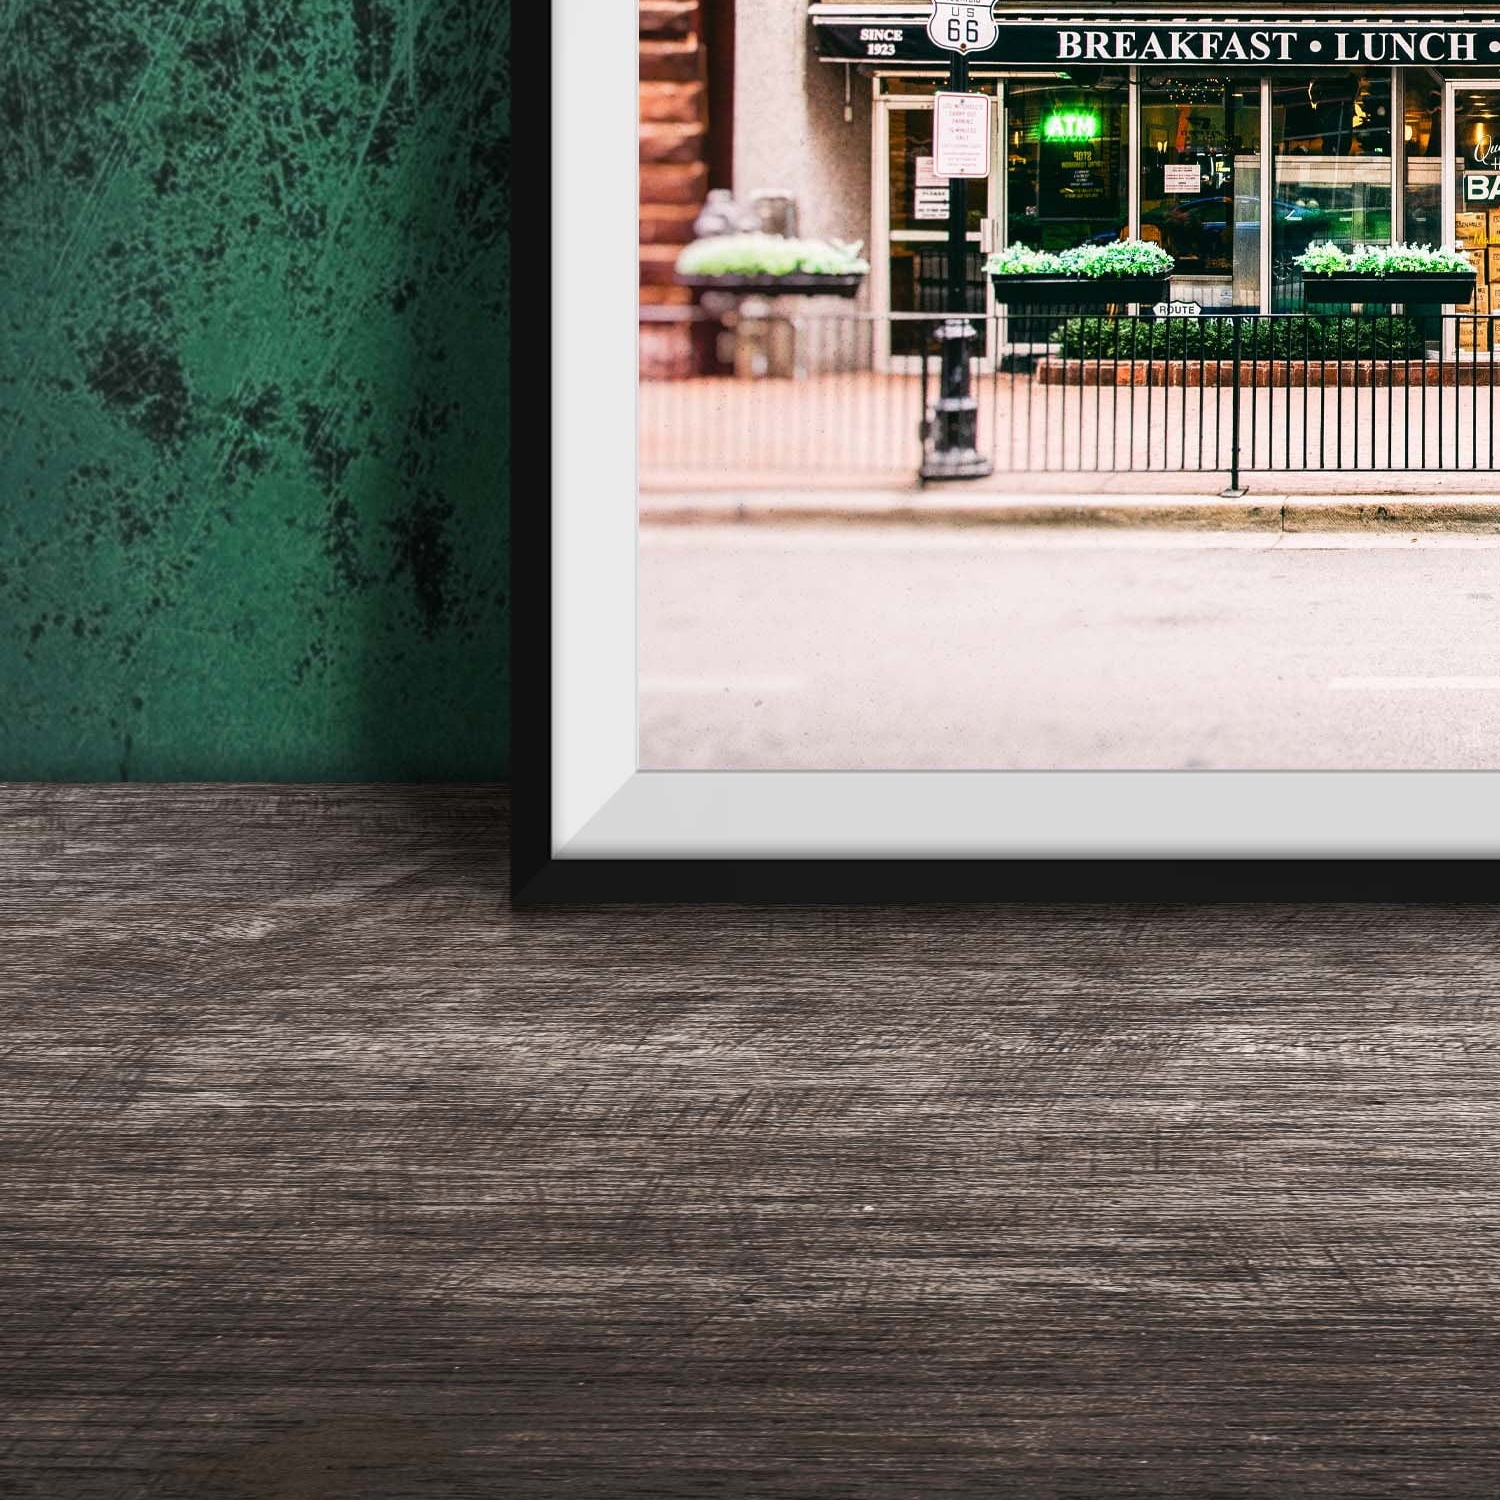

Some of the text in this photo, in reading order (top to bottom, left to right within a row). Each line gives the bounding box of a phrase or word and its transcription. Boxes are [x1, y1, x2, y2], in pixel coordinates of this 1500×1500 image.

[860, 28, 903, 42] SINCE
[948, 19, 979, 43] 66
[866, 43, 896, 56] 1923
[1056, 30, 1298, 63] BREAKFAST
[1333, 32, 1478, 63] LUNCH
[1044, 114, 1098, 138] ATM
[1159, 305, 1195, 315] ROUTE
